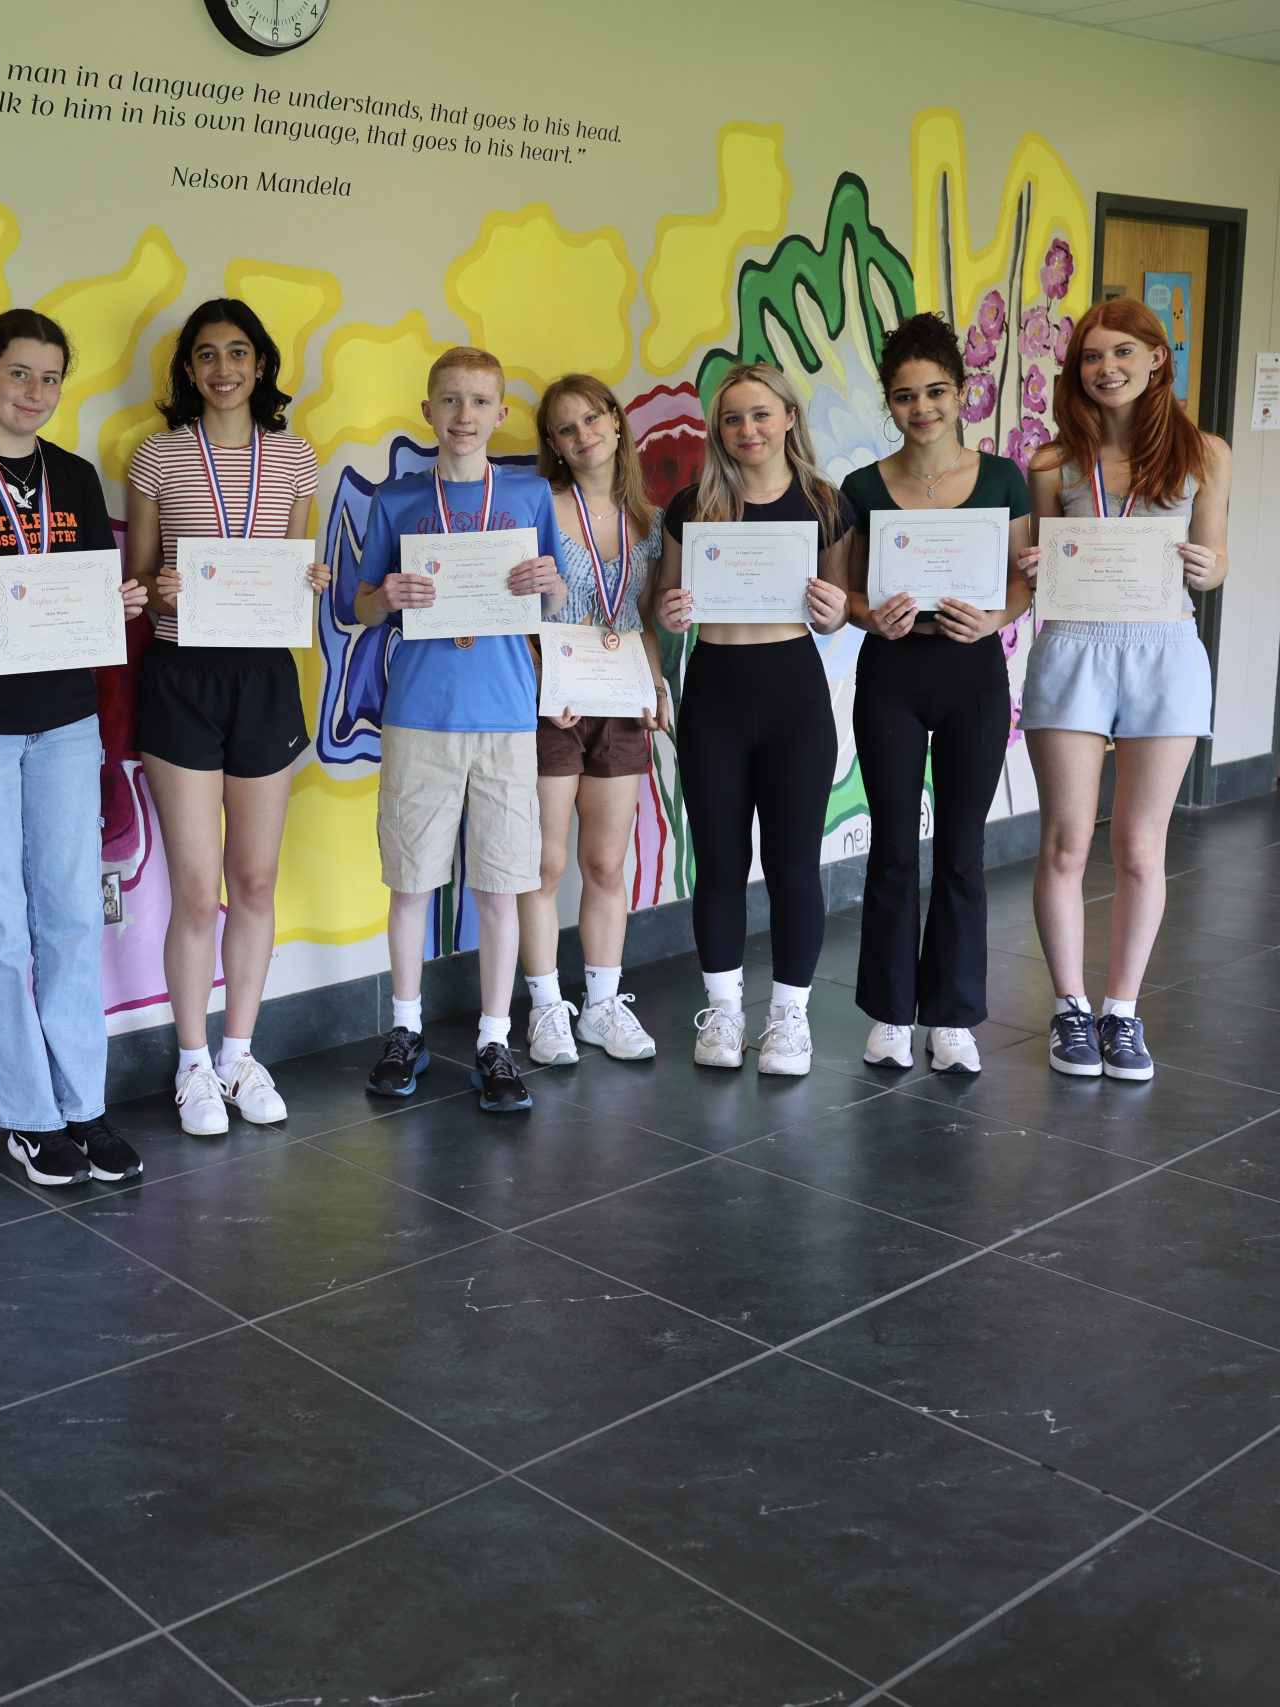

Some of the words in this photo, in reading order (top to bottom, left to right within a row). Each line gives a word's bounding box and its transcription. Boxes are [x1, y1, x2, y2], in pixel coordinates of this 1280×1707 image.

[311, 4, 319, 18] 4
[249, 16, 256, 31] 7
[294, 23, 302, 37] 5
[271, 27, 279, 42] 6
[7, 63, 67, 85] man
[76, 65, 99, 88] in
[108, 73, 123, 90] a
[132, 70, 245, 105] language
[253, 82, 281, 105] he
[288, 90, 423, 123] understands,
[430, 102, 469, 125] that
[472, 112, 517, 132] goes
[522, 113, 540, 133] to
[545, 116, 570, 137] his
[575, 120, 621, 143] head.
[31, 93, 55, 117] to
[63, 96, 112, 122] him
[121, 101, 144, 124] in
[152, 104, 186, 127] his
[194, 113, 246, 132] own
[253, 113, 360, 146] language,
[367, 124, 408, 147] that
[412, 134, 457, 154] goes
[464, 134, 482, 155] to
[487, 137, 514, 158] his
[170, 166, 249, 191] Nelson
[255, 171, 352, 197] Mandela
